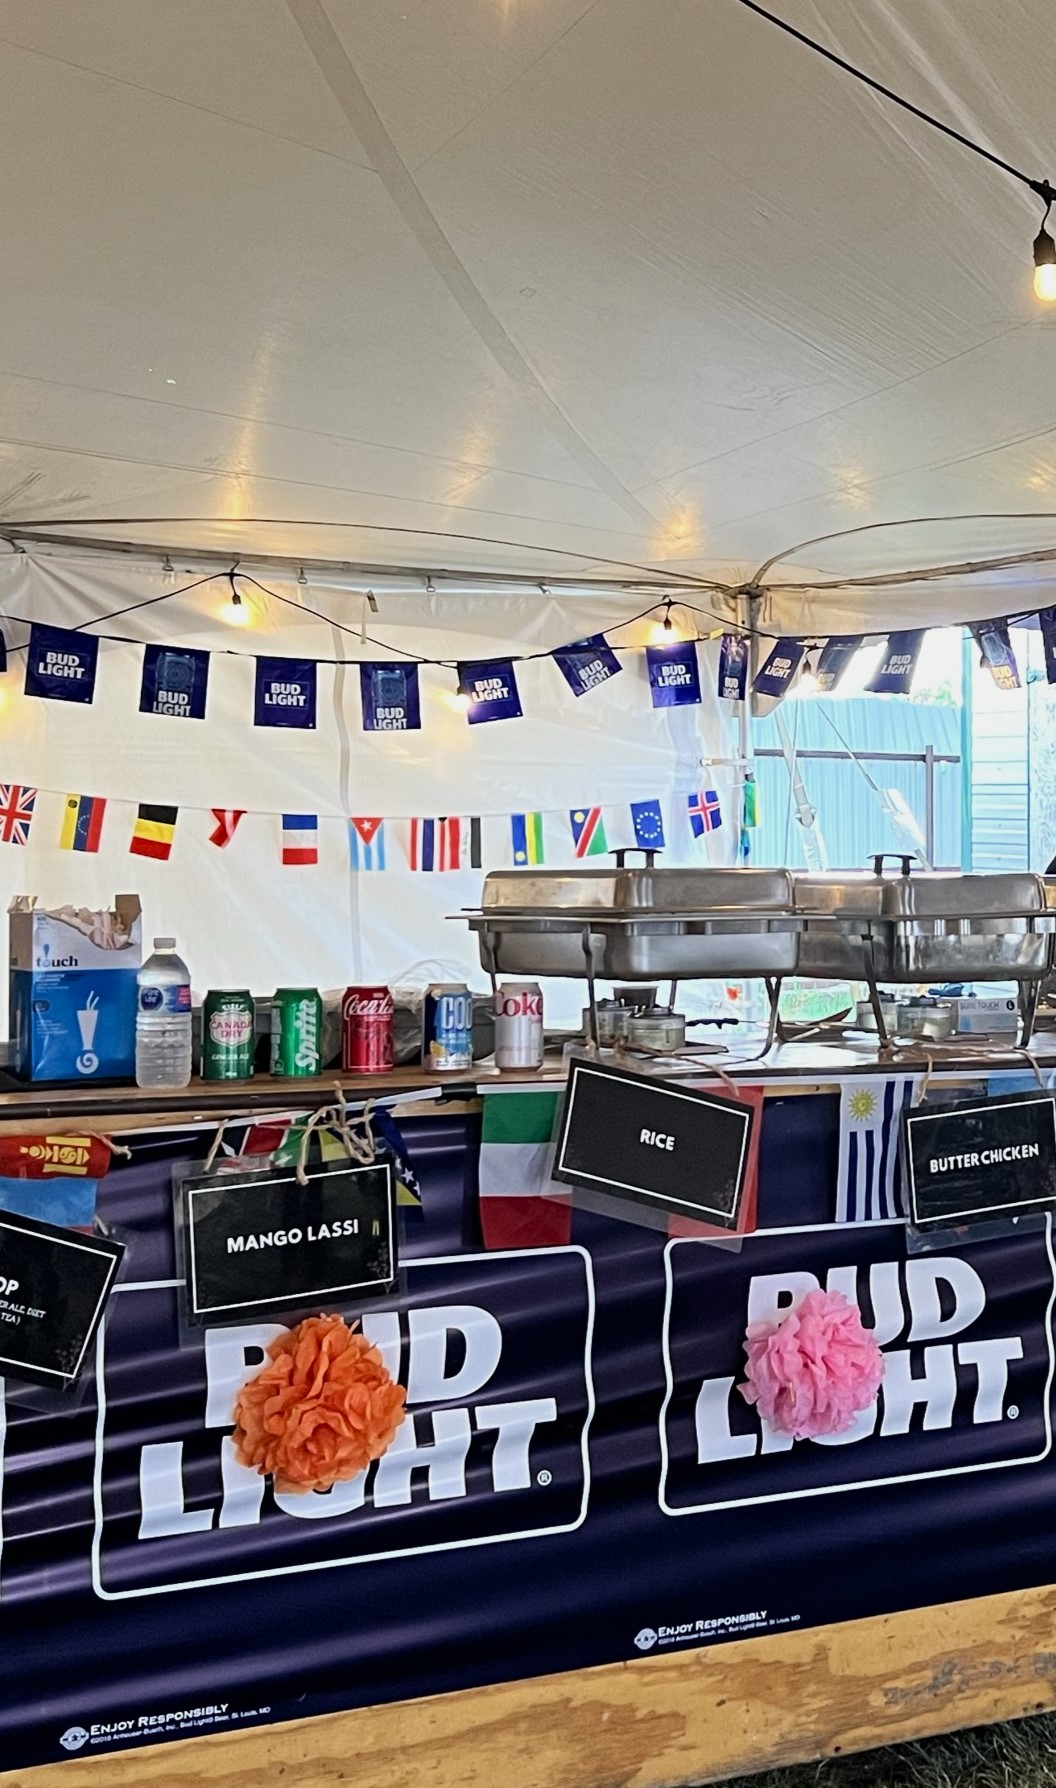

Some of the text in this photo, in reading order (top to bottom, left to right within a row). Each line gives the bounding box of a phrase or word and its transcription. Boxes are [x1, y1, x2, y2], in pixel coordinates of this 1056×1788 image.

[46, 652, 79, 668] BUD
[772, 658, 792, 668] BUD
[890, 654, 912, 664] BUD
[38, 661, 85, 680] LIGHT
[578, 660, 602, 680] BUD
[662, 664, 686, 676] BUD
[765, 666, 791, 678] LIGHT
[881, 664, 912, 675] LIGHT
[474, 678, 502, 690] BUD
[658, 674, 691, 686] LIGHT
[724, 677, 738, 688] BUD
[270, 683, 300, 695] BUD
[472, 687, 509, 702] LIGHT
[158, 691, 188, 704] BUD
[264, 693, 306, 706] LIGHT
[152, 701, 190, 717] LIGHT
[376, 708, 404, 719] BUD
[374, 718, 408, 730] LIGHT
[36, 956, 78, 968] touch
[221, 1030, 243, 1038] DRY
[640, 1128, 675, 1150] RICE
[929, 1143, 1039, 1174] BUTTER CHICKEN
[227, 1219, 359, 1254] MANGO LASSI
[8, 1303, 26, 1315] ALE
[658, 1623, 693, 1637] ENJOY
[696, 1610, 767, 1630] RESPONSIBLY
[90, 1704, 228, 1736] ENJOY RESPONSIBLY
